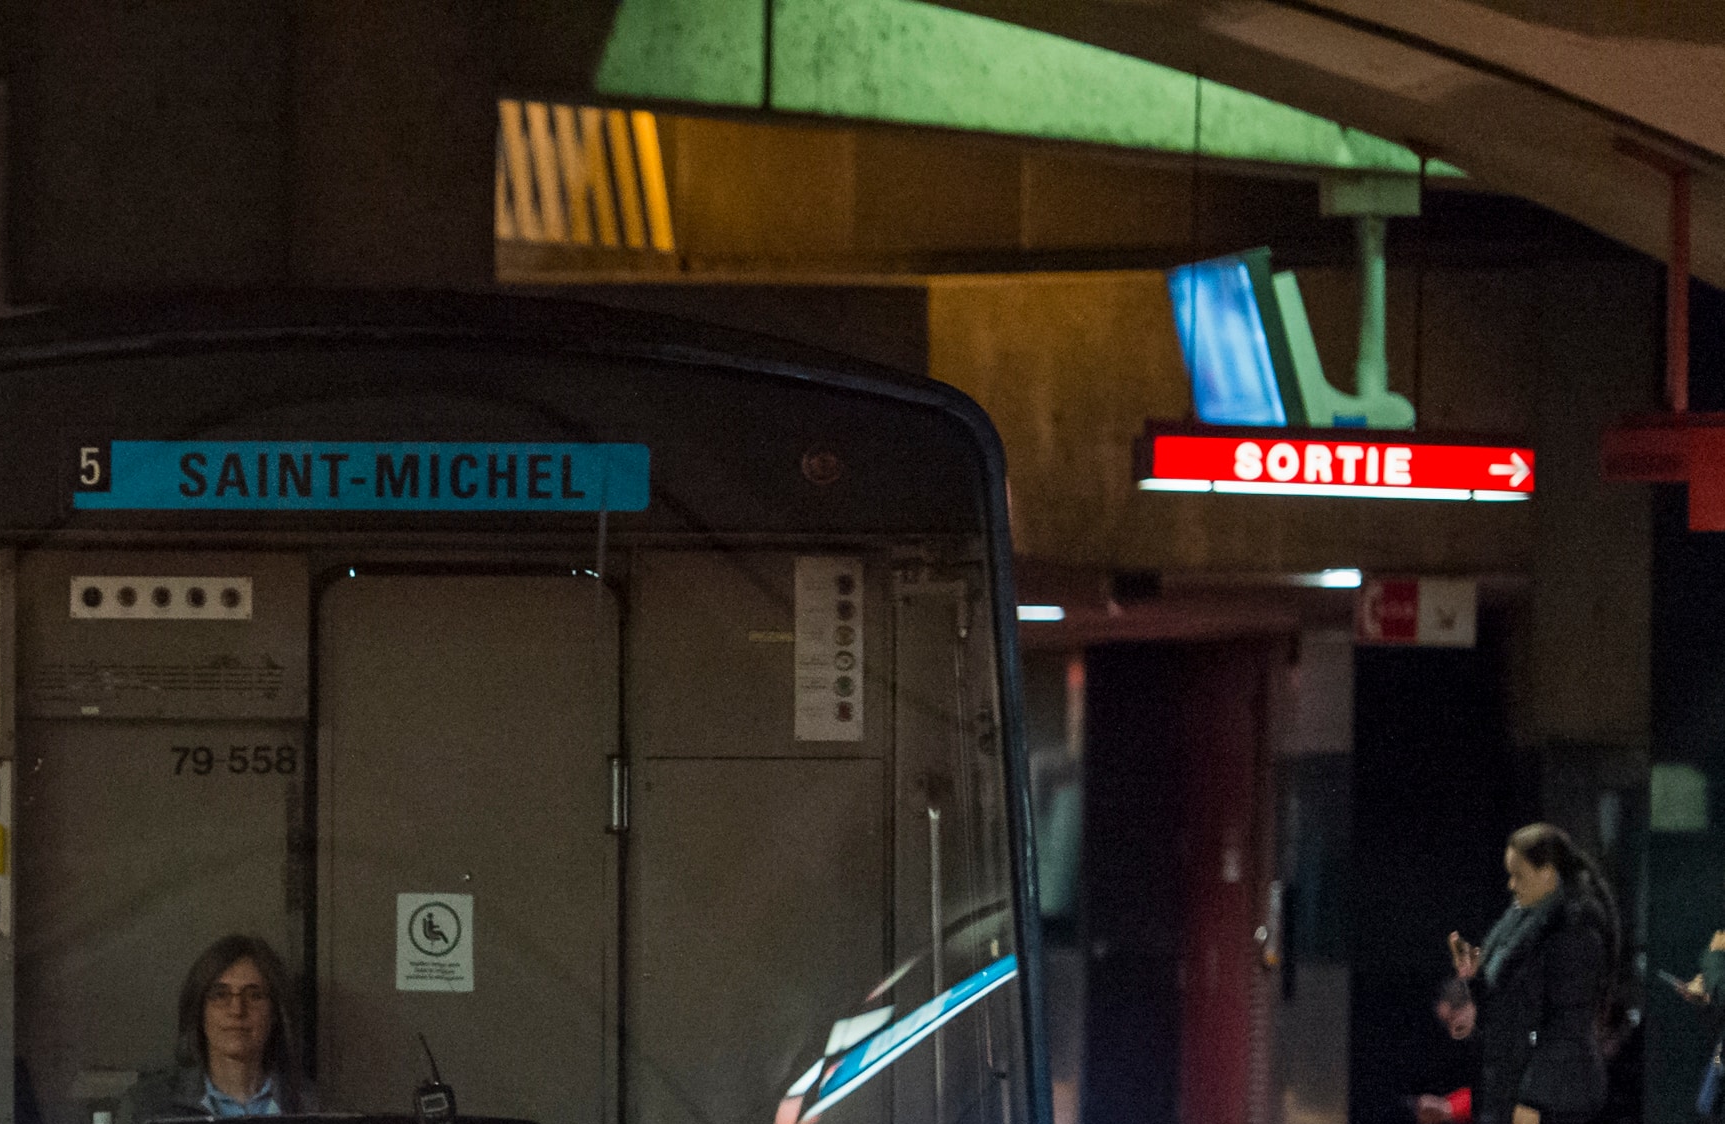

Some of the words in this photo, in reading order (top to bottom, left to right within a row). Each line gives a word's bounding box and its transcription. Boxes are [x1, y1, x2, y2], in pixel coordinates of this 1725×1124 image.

[79, 446, 101, 486] 5
[178, 452, 587, 499] SAINT-MICHEL
[1233, 440, 1414, 486] SORTIE
